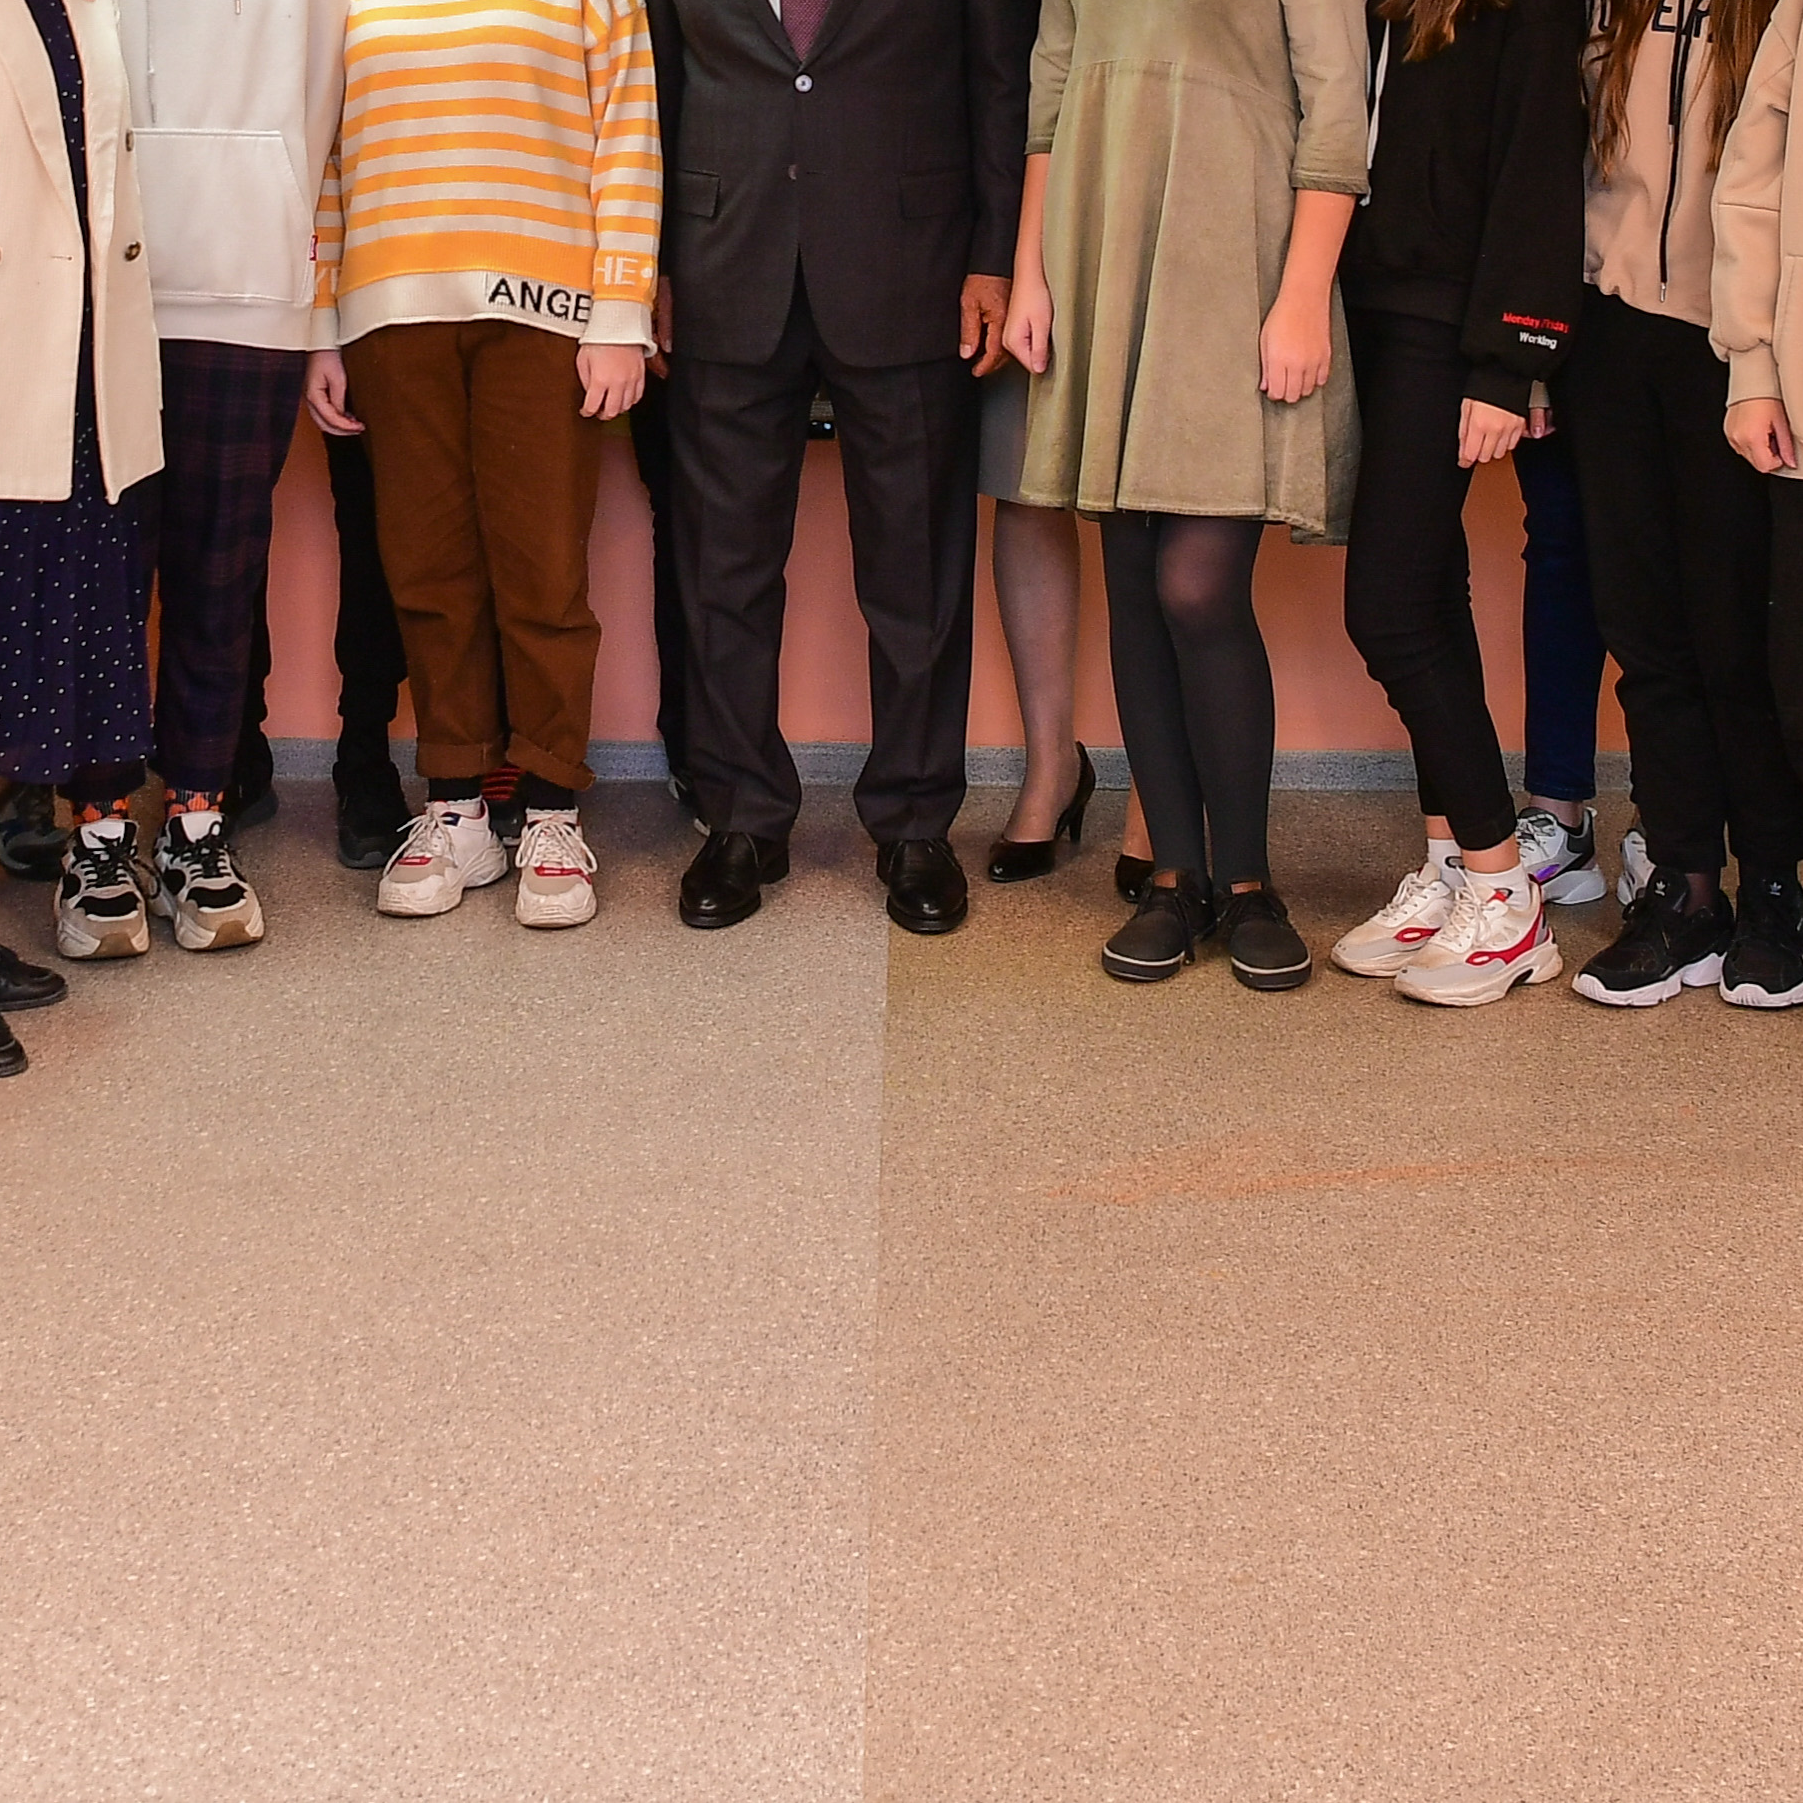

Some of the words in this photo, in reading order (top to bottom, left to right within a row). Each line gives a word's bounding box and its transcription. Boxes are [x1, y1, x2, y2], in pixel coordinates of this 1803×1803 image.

[488, 277, 592, 323] ANGE
[1502, 312, 1540, 329] Monday
[1519, 331, 1557, 350] Working
